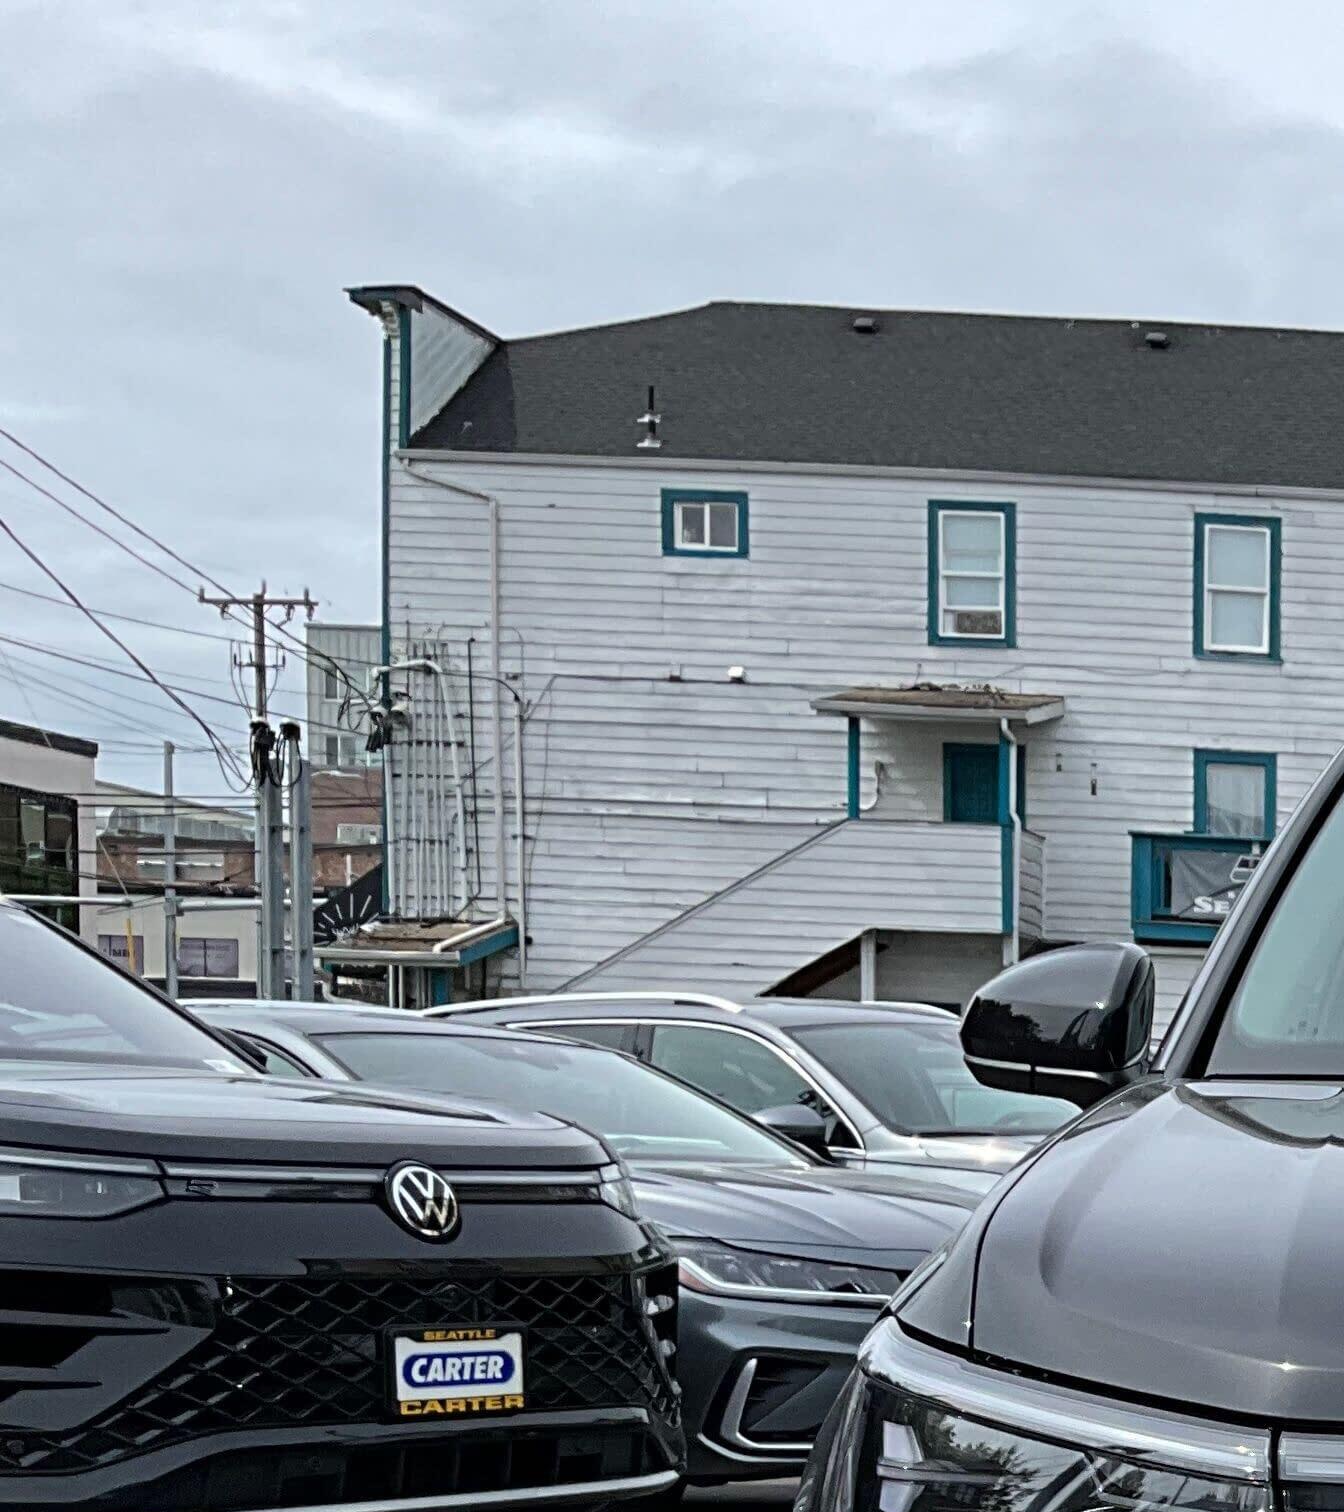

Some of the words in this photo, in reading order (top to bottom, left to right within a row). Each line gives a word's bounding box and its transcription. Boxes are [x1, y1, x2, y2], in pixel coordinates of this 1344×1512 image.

[423, 1329, 496, 1341] SEATTLE
[411, 1355, 504, 1383] CARTER
[400, 1395, 524, 1415] CARTER
